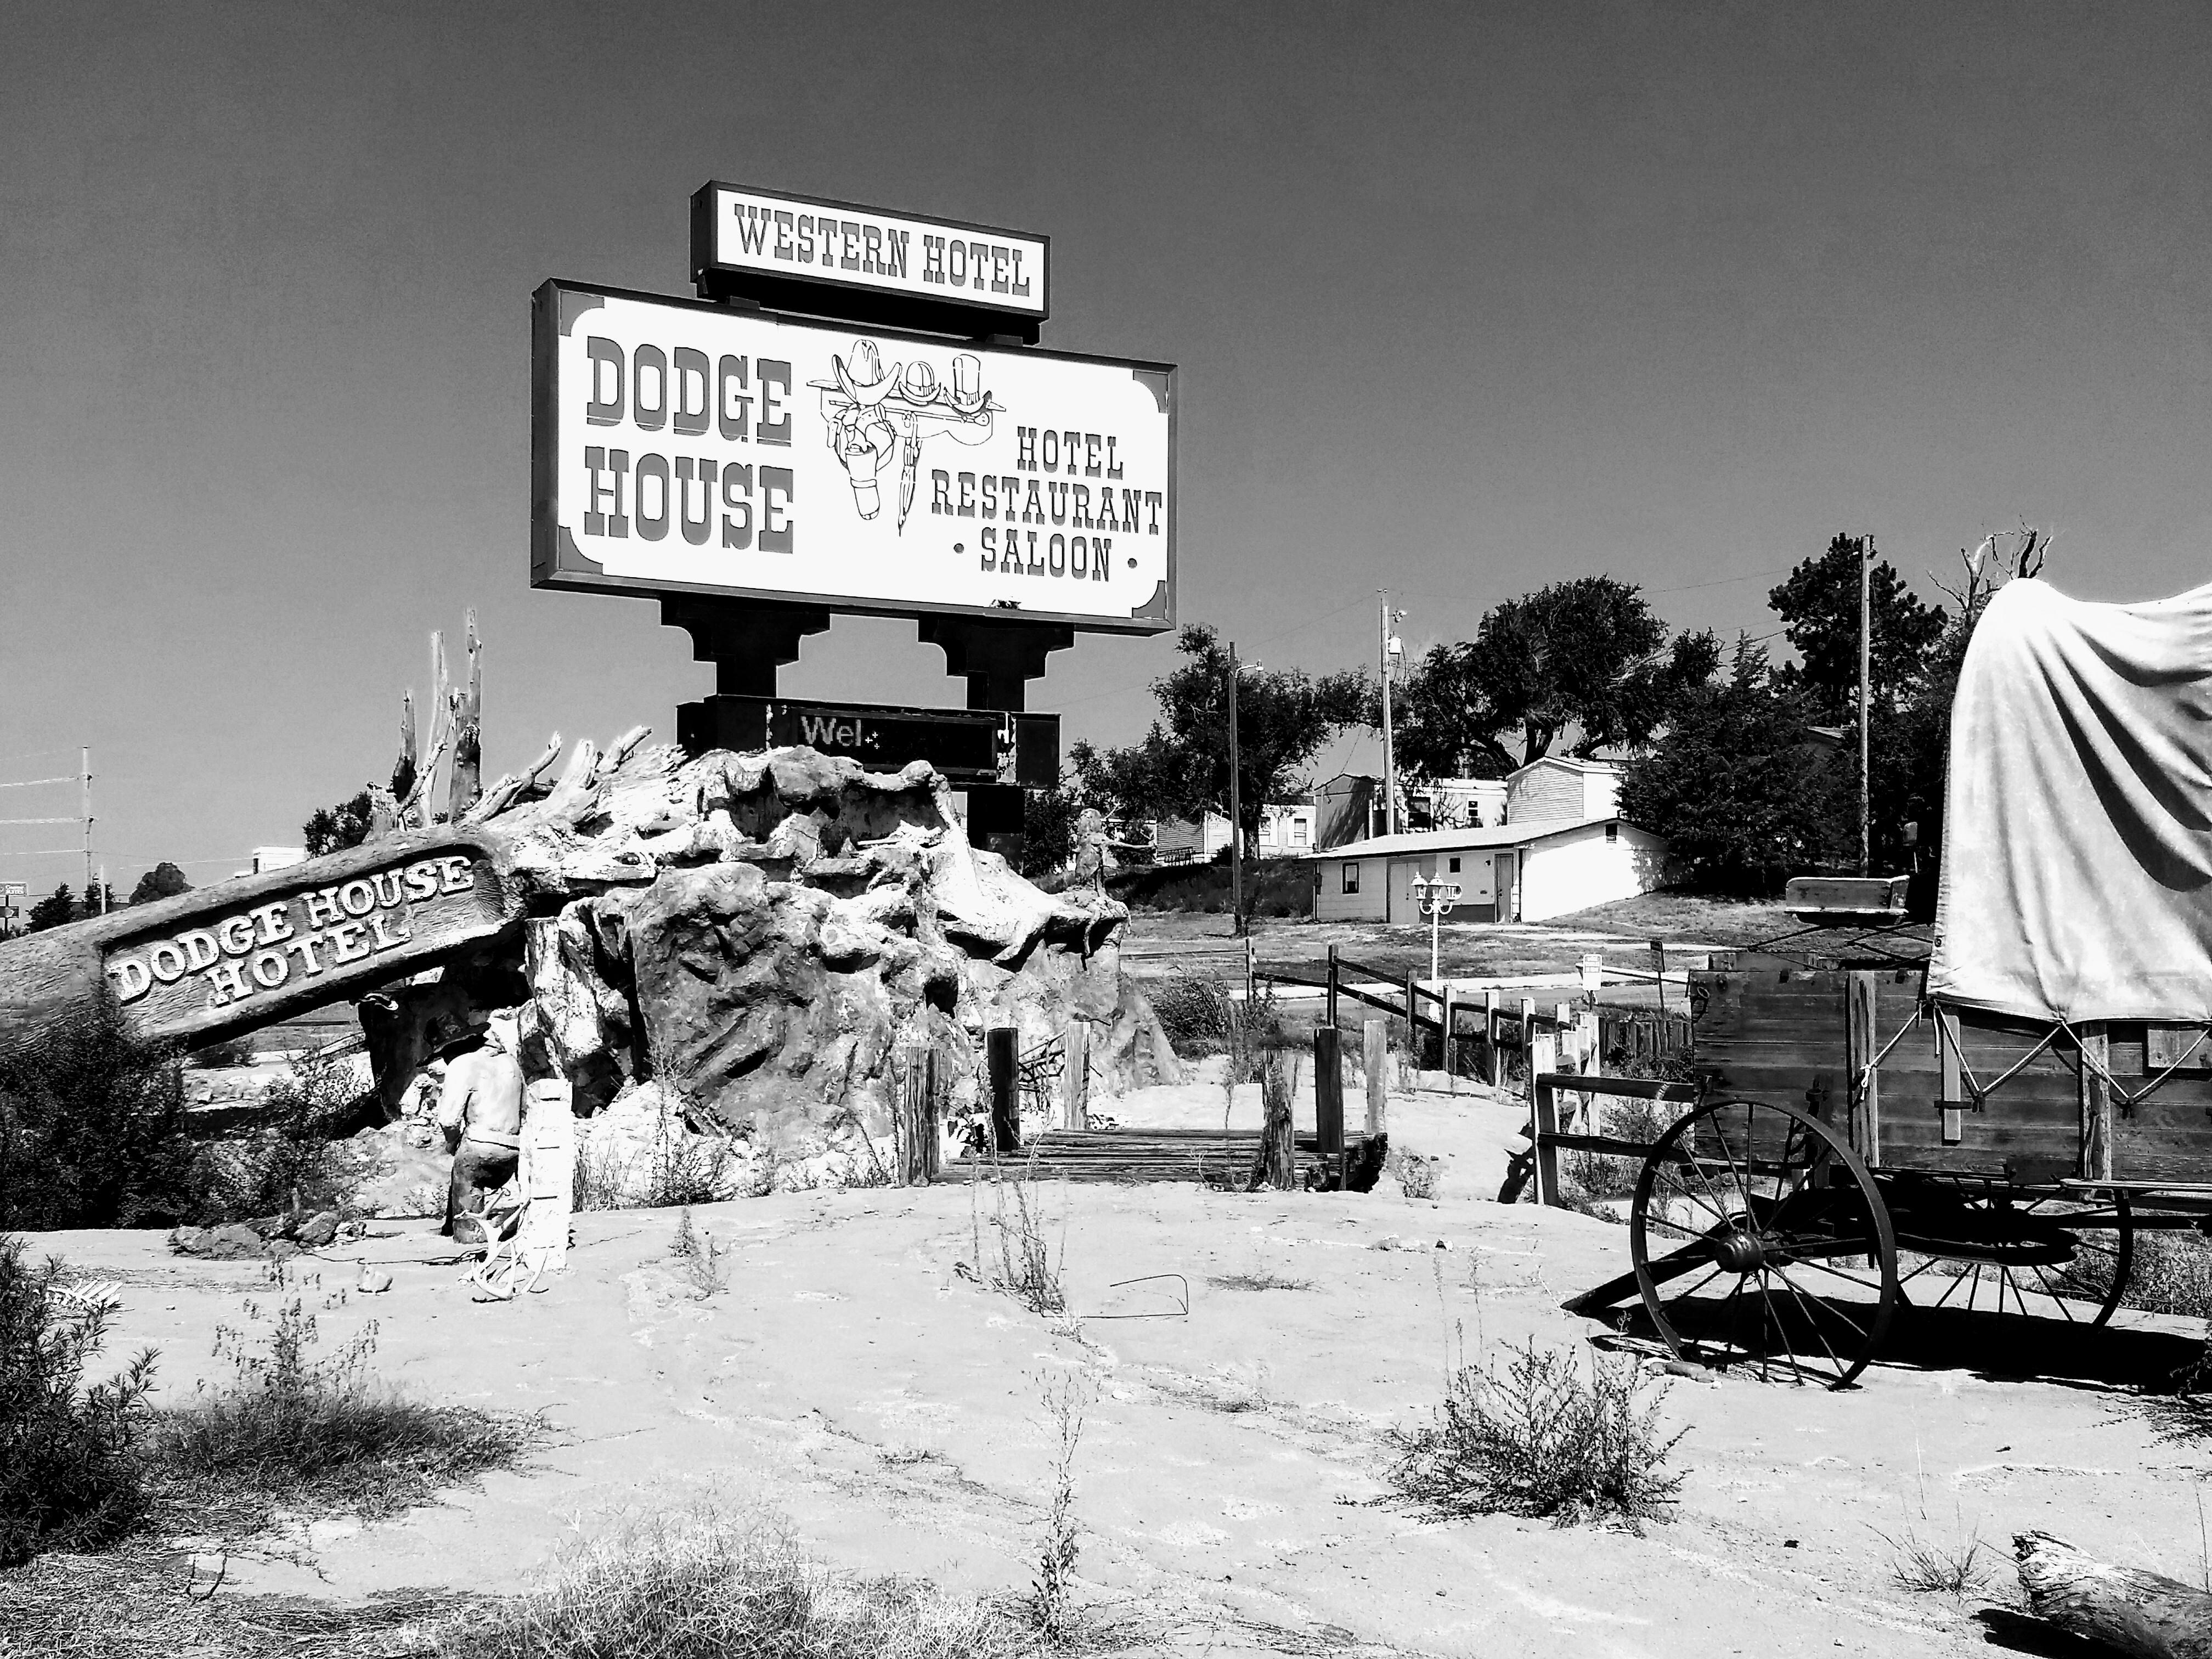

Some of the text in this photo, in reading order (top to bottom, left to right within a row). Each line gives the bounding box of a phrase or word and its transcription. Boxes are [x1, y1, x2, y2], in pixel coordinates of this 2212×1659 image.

[734, 203, 1030, 297] WESTERN HOTEL
[586, 335, 792, 448] DODGE
[1017, 425, 1124, 481] HOTEL
[584, 445, 794, 555] HOUSE
[932, 468, 1162, 536] RESTAURANT
[981, 526, 1112, 583] SALOON
[109, 856, 474, 1001] DODGE HOUSE
[206, 917, 411, 1005] HOTEL
